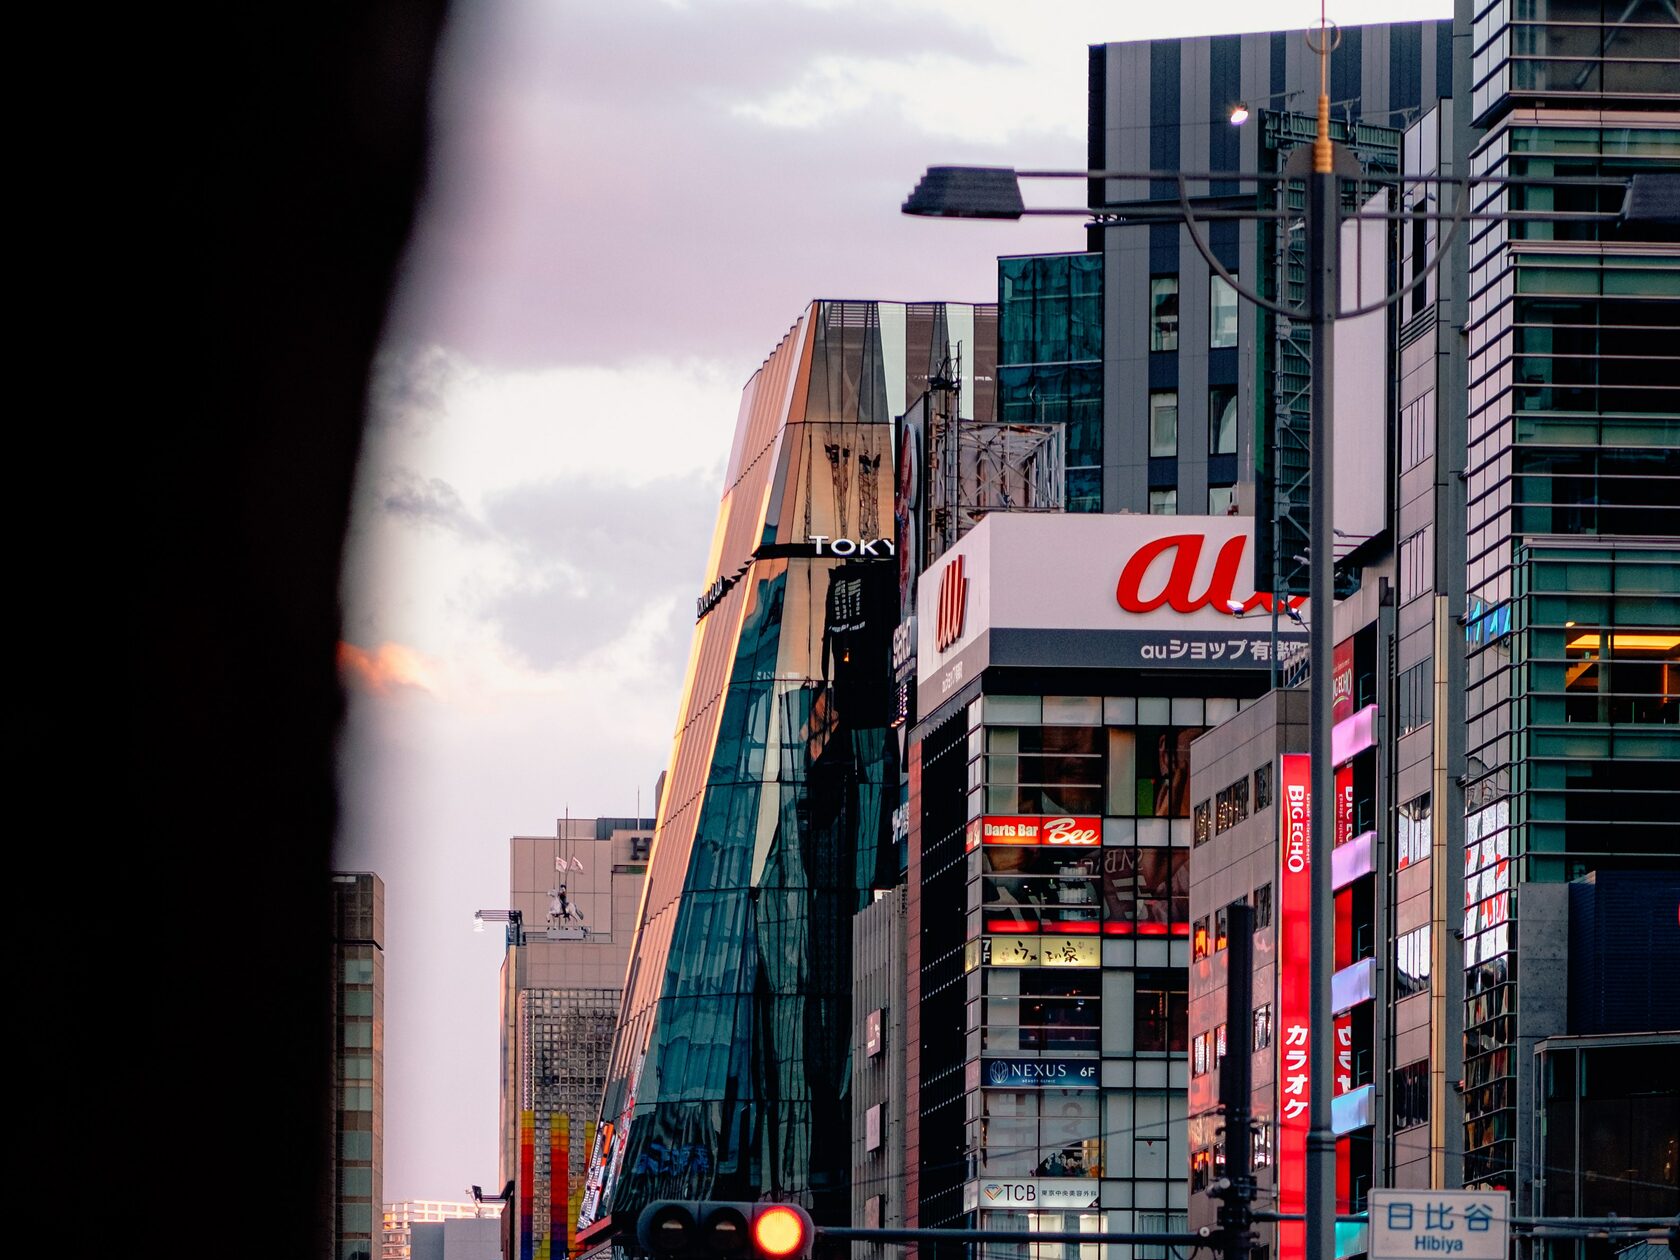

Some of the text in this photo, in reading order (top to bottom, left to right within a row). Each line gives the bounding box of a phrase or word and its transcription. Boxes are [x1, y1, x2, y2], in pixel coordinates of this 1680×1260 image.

[984, 824, 1016, 837] Darts
[1017, 824, 1039, 837] Bar
[1043, 817, 1099, 844] Bee
[1287, 785, 1304, 873] BIG ECHO
[1011, 1063, 1096, 1077] NEXUS 6F
[1284, 1025, 1309, 1119] カラオケ
[1003, 1184, 1037, 1201] TCB
[1388, 1202, 1493, 1231] 日比谷
[1414, 1235, 1464, 1254] Hibiya
